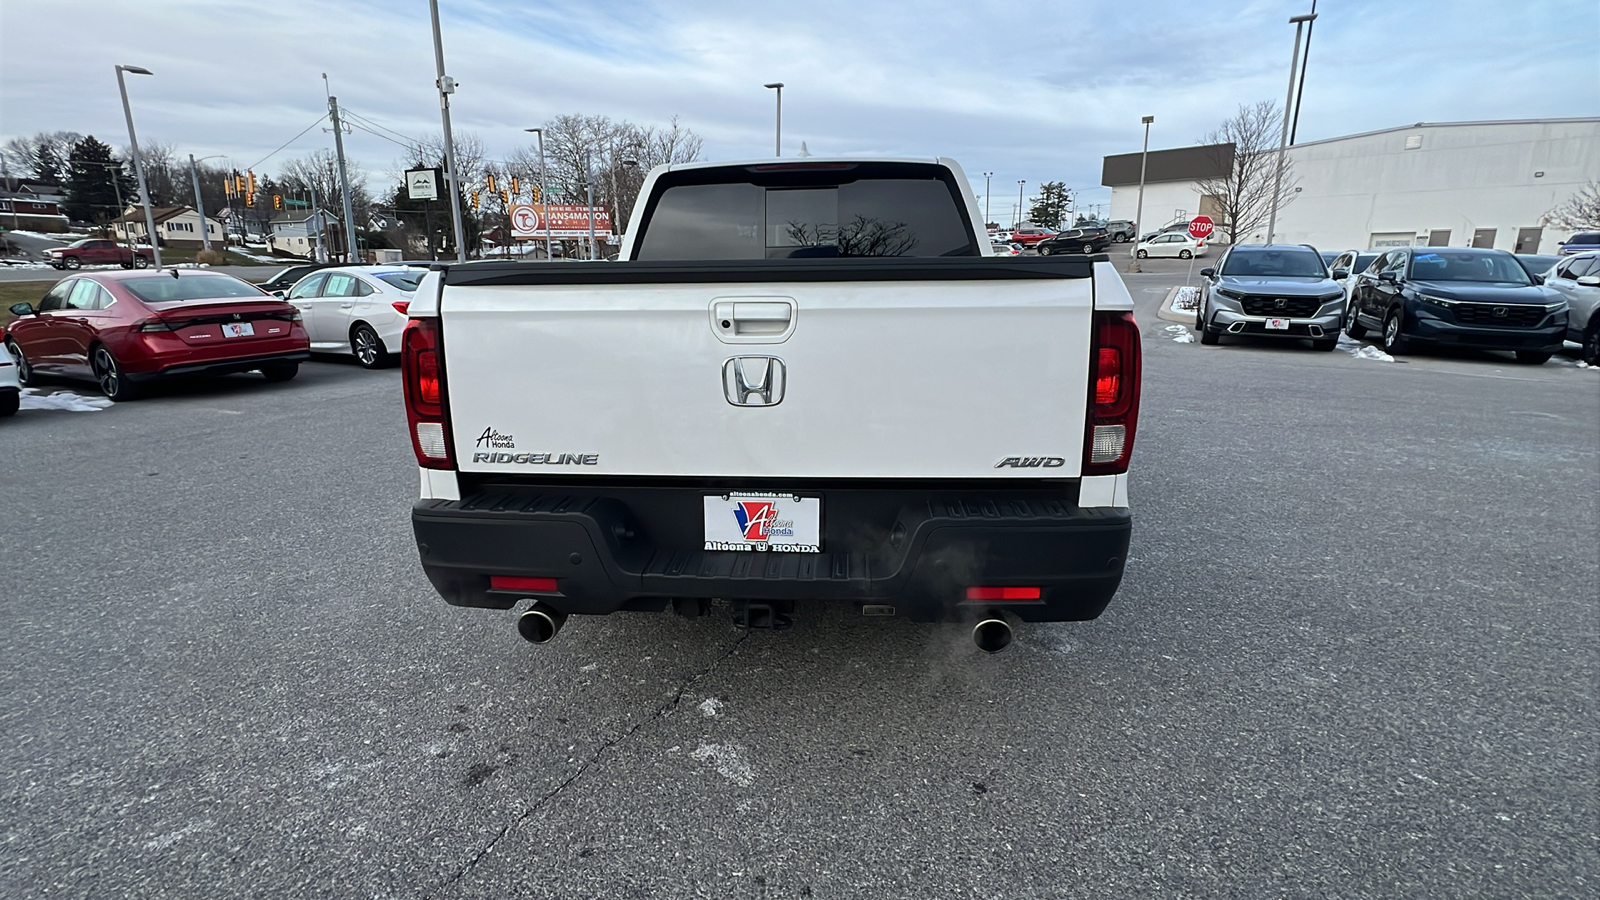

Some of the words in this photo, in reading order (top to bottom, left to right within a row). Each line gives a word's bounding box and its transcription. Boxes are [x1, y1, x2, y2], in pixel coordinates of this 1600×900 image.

[1190, 222, 1212, 232] STOP
[476, 426, 513, 448] Altoona
[492, 440, 515, 449] Honda
[472, 452, 599, 466] RIDGELINE
[994, 456, 1066, 468] AWD
[744, 504, 793, 536] Altoona
[763, 526, 793, 536] Honda
[704, 541, 752, 552] Altoona
[772, 544, 820, 553] HONDA
